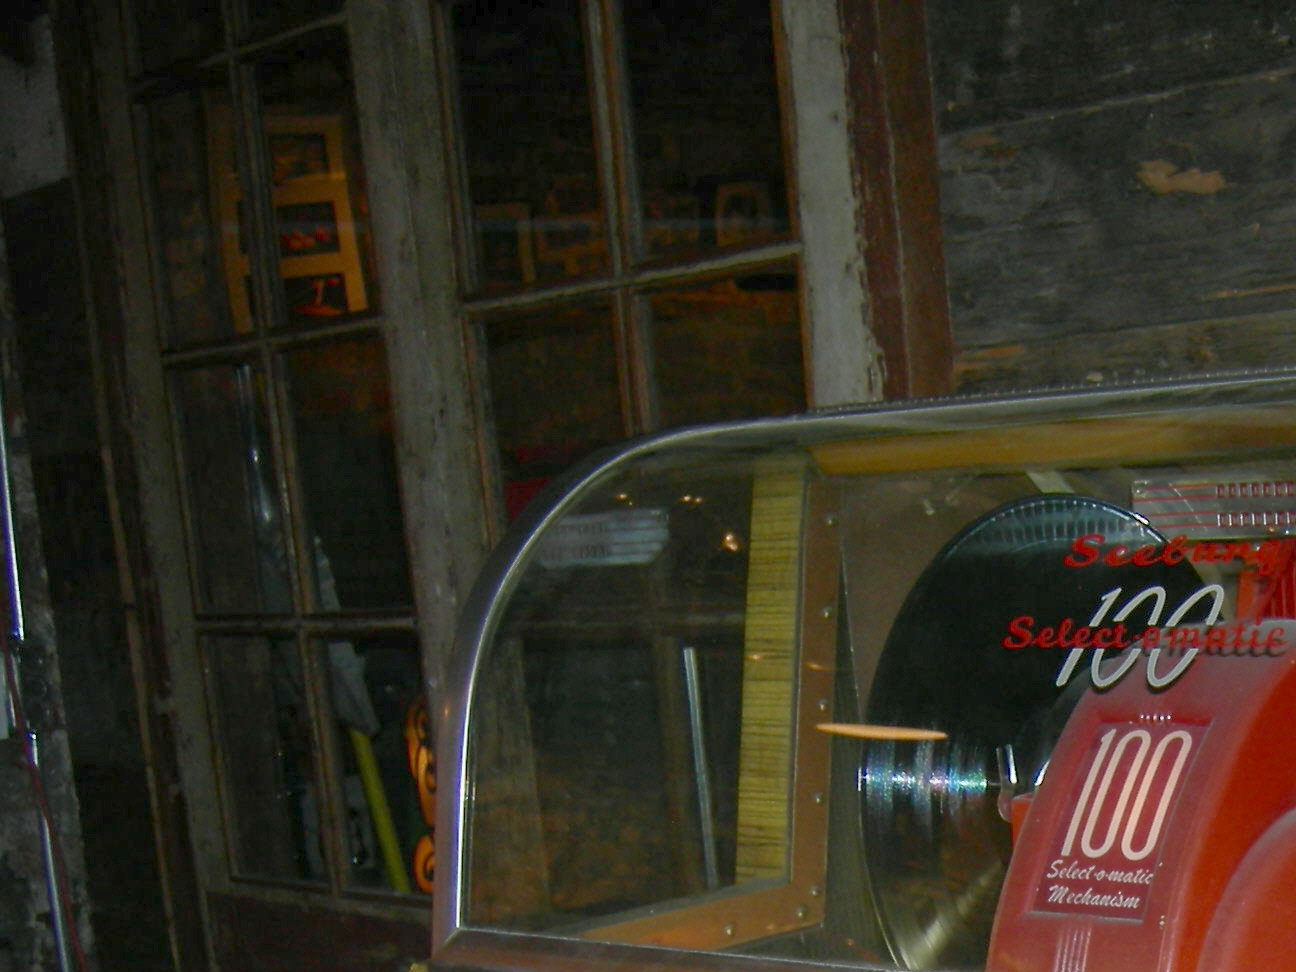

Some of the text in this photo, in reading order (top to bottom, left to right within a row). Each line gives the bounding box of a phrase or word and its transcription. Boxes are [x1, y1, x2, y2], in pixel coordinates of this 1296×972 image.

[1055, 583, 1226, 688] 100
[1060, 728, 1193, 861] 100
[1047, 884, 1140, 909] Mechanism
